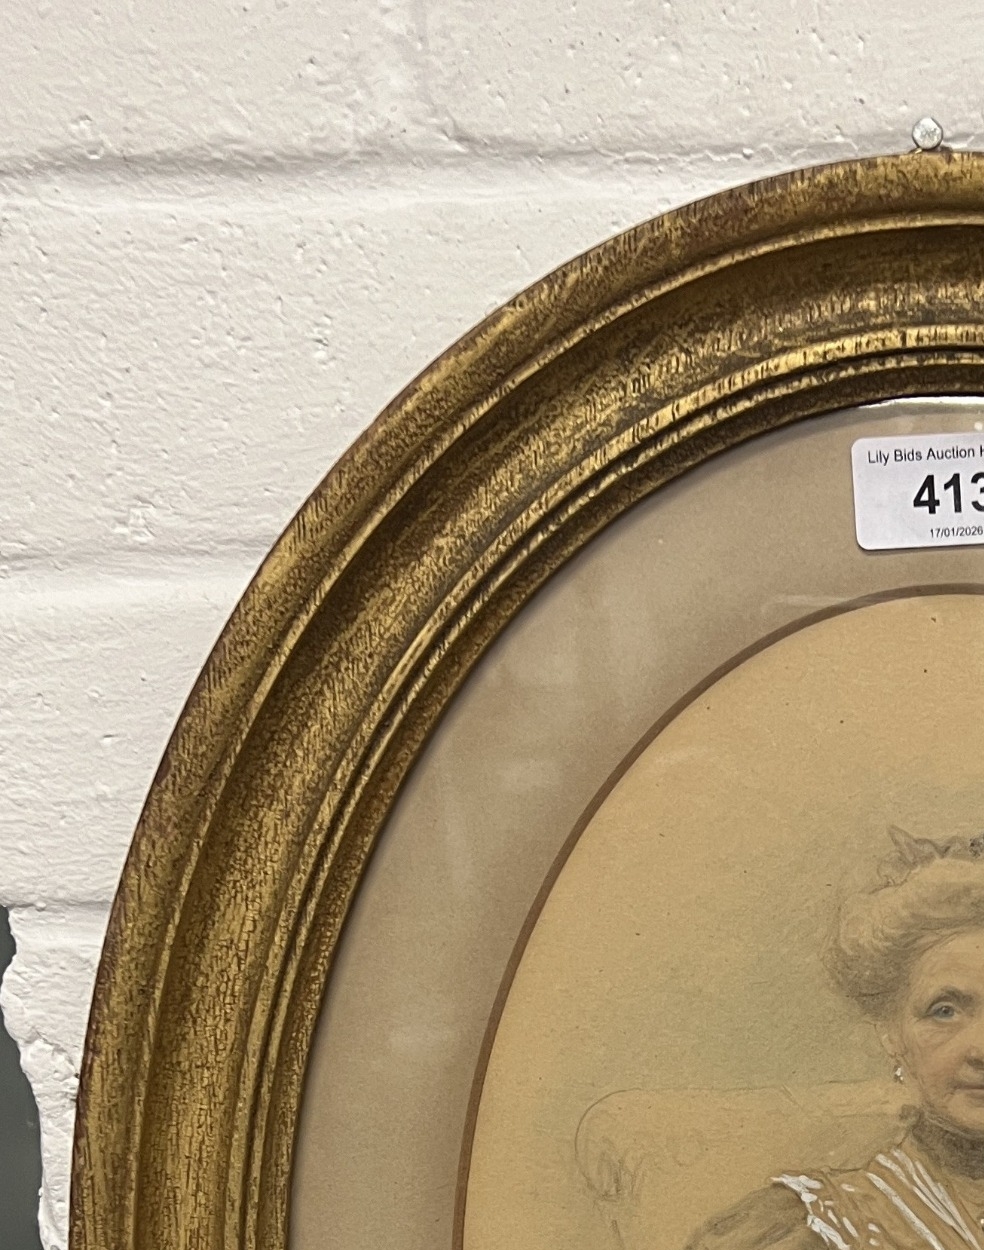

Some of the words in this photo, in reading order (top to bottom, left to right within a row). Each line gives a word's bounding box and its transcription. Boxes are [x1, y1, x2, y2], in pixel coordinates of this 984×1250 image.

[867, 450, 890, 466] Lily
[894, 449, 923, 463] Bids
[926, 446, 975, 461] Auction
[930, 525, 984, 539] 17/01/2026
